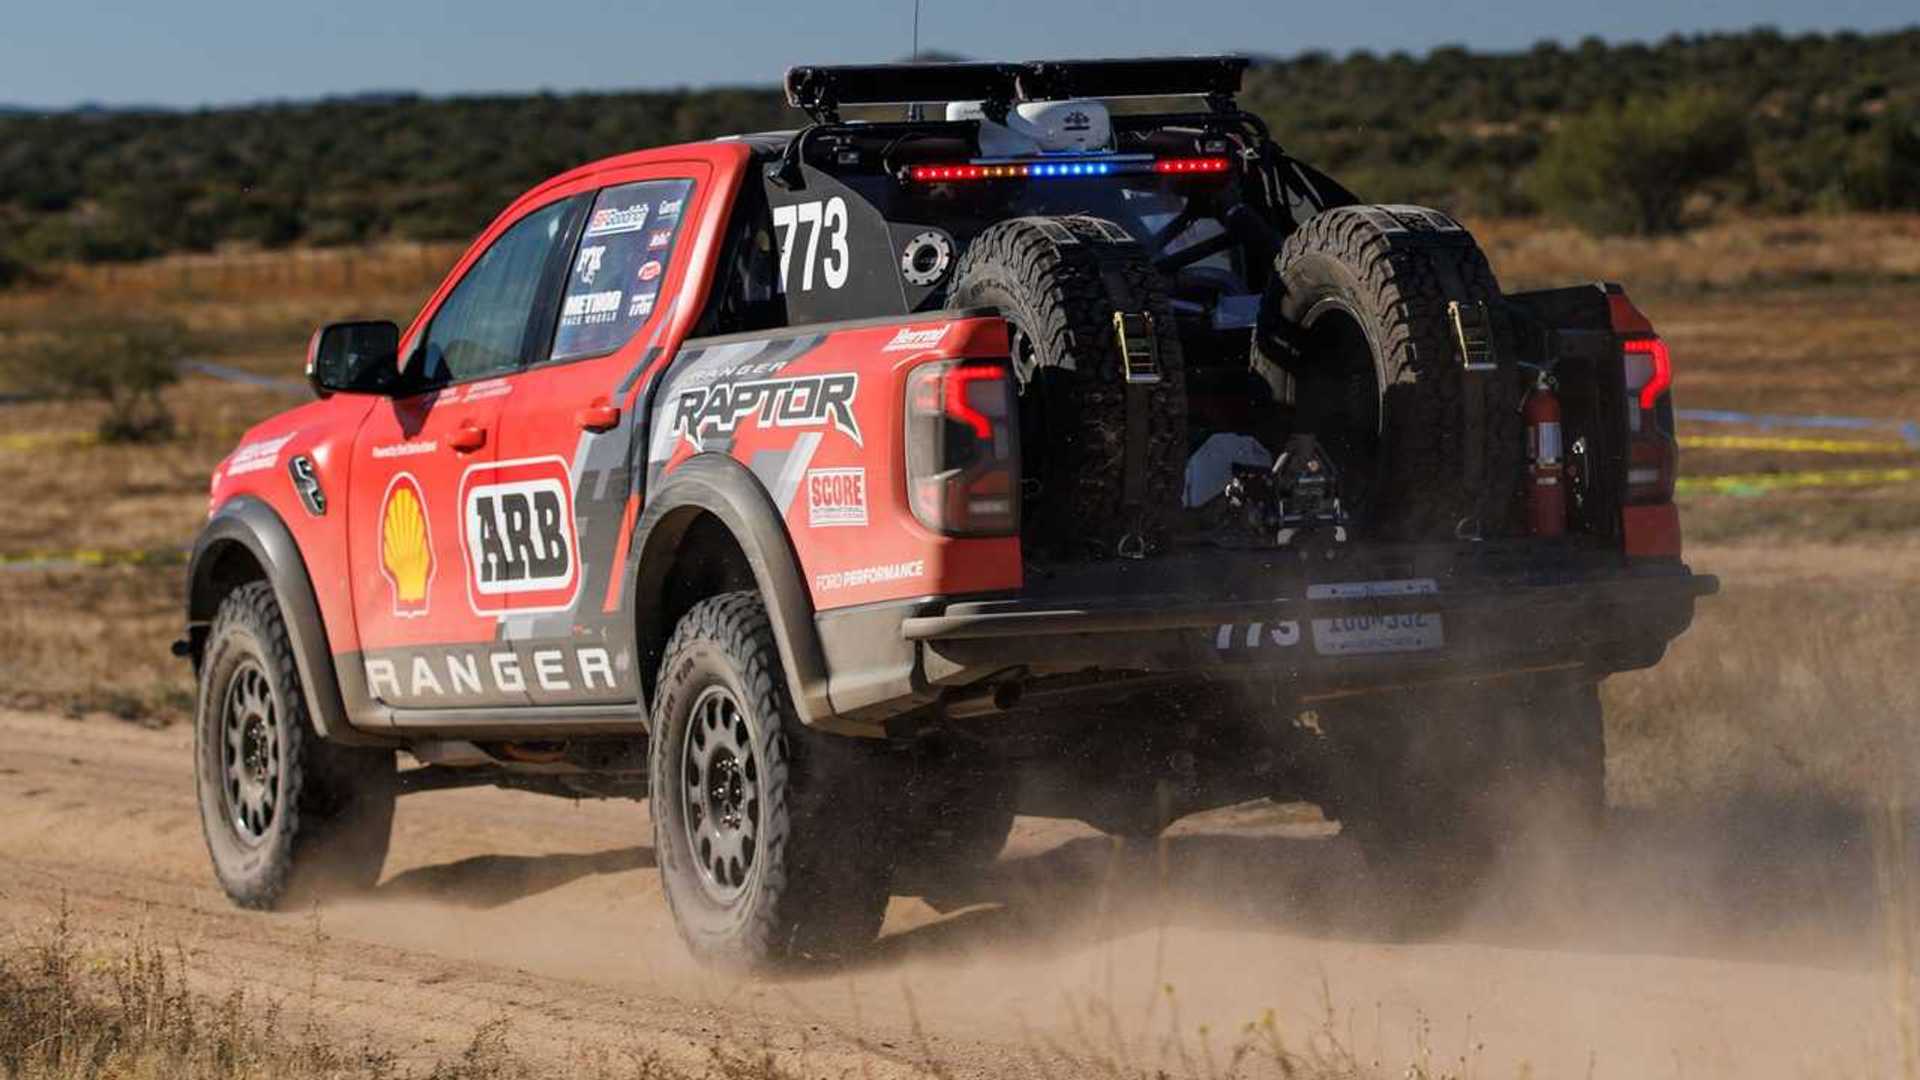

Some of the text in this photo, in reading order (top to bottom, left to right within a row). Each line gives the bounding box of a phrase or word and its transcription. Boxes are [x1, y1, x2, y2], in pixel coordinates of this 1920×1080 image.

[773, 196, 849, 293] 773
[673, 372, 864, 452] RAPTOR
[811, 475, 863, 507] SCORE
[476, 490, 569, 582] ARB
[815, 560, 924, 591] FORD PERFORMANCE
[366, 647, 616, 699] RANGER
